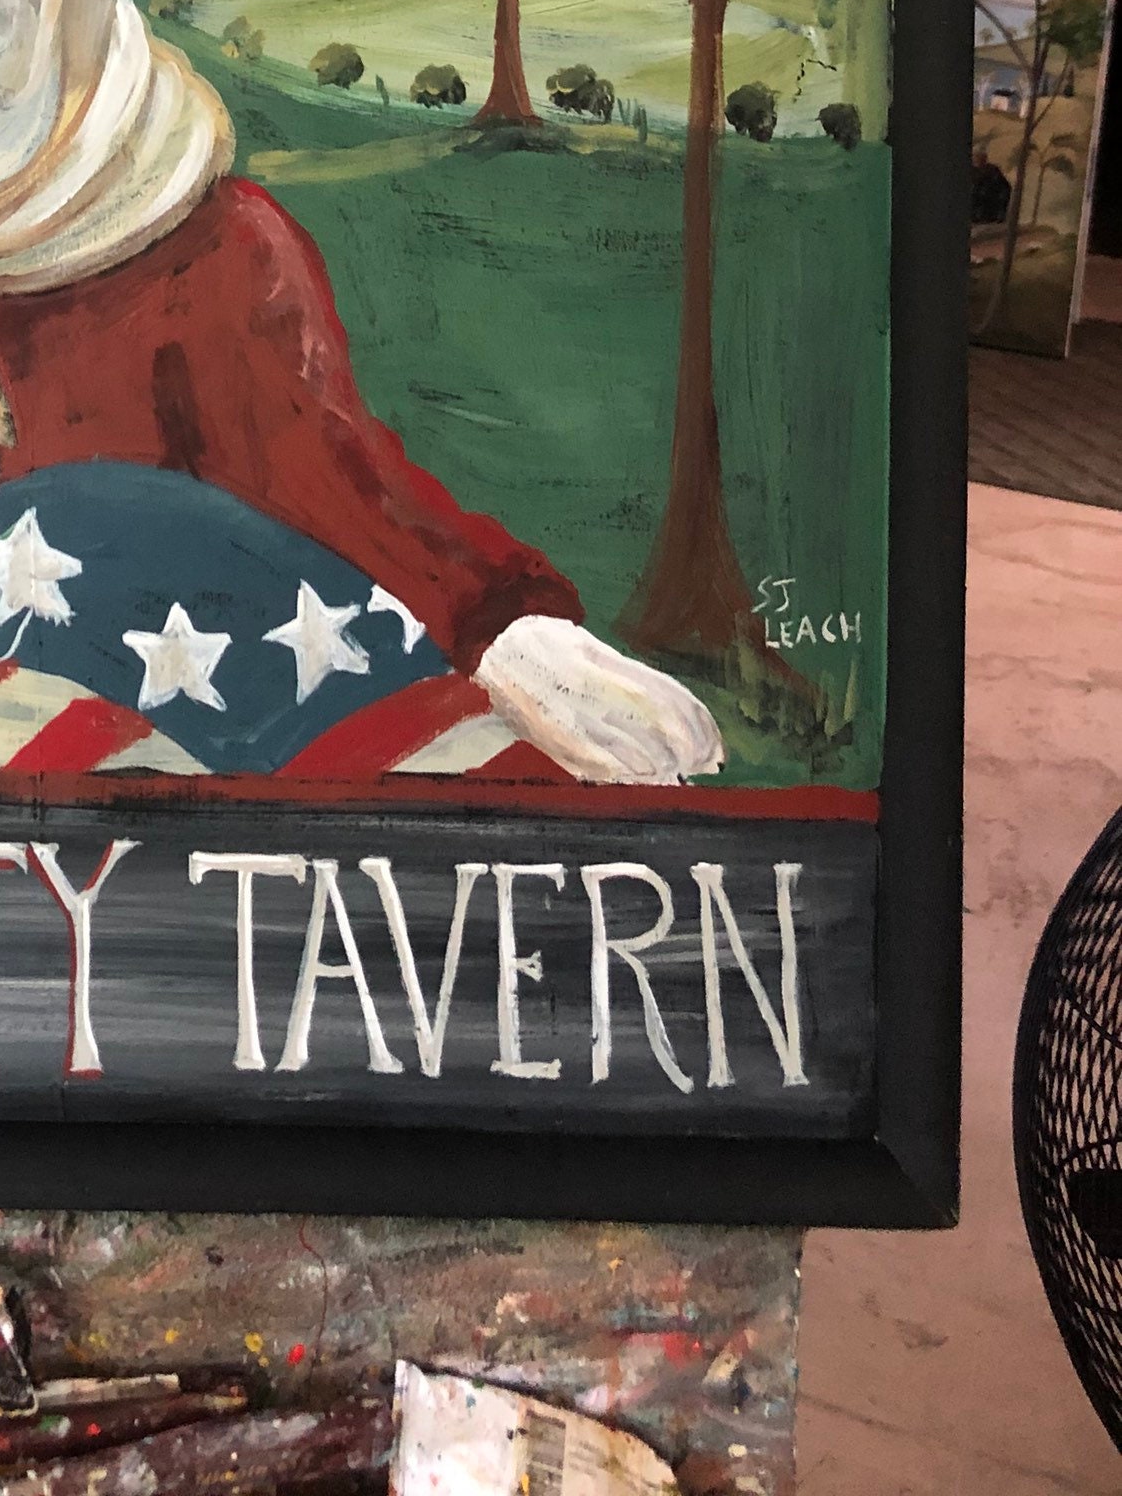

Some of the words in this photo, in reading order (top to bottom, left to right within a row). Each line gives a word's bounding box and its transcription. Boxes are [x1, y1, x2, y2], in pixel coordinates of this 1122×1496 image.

[751, 575, 796, 613] SJ
[764, 611, 861, 649] LEACH
[188, 851, 810, 1094] TAVERN
